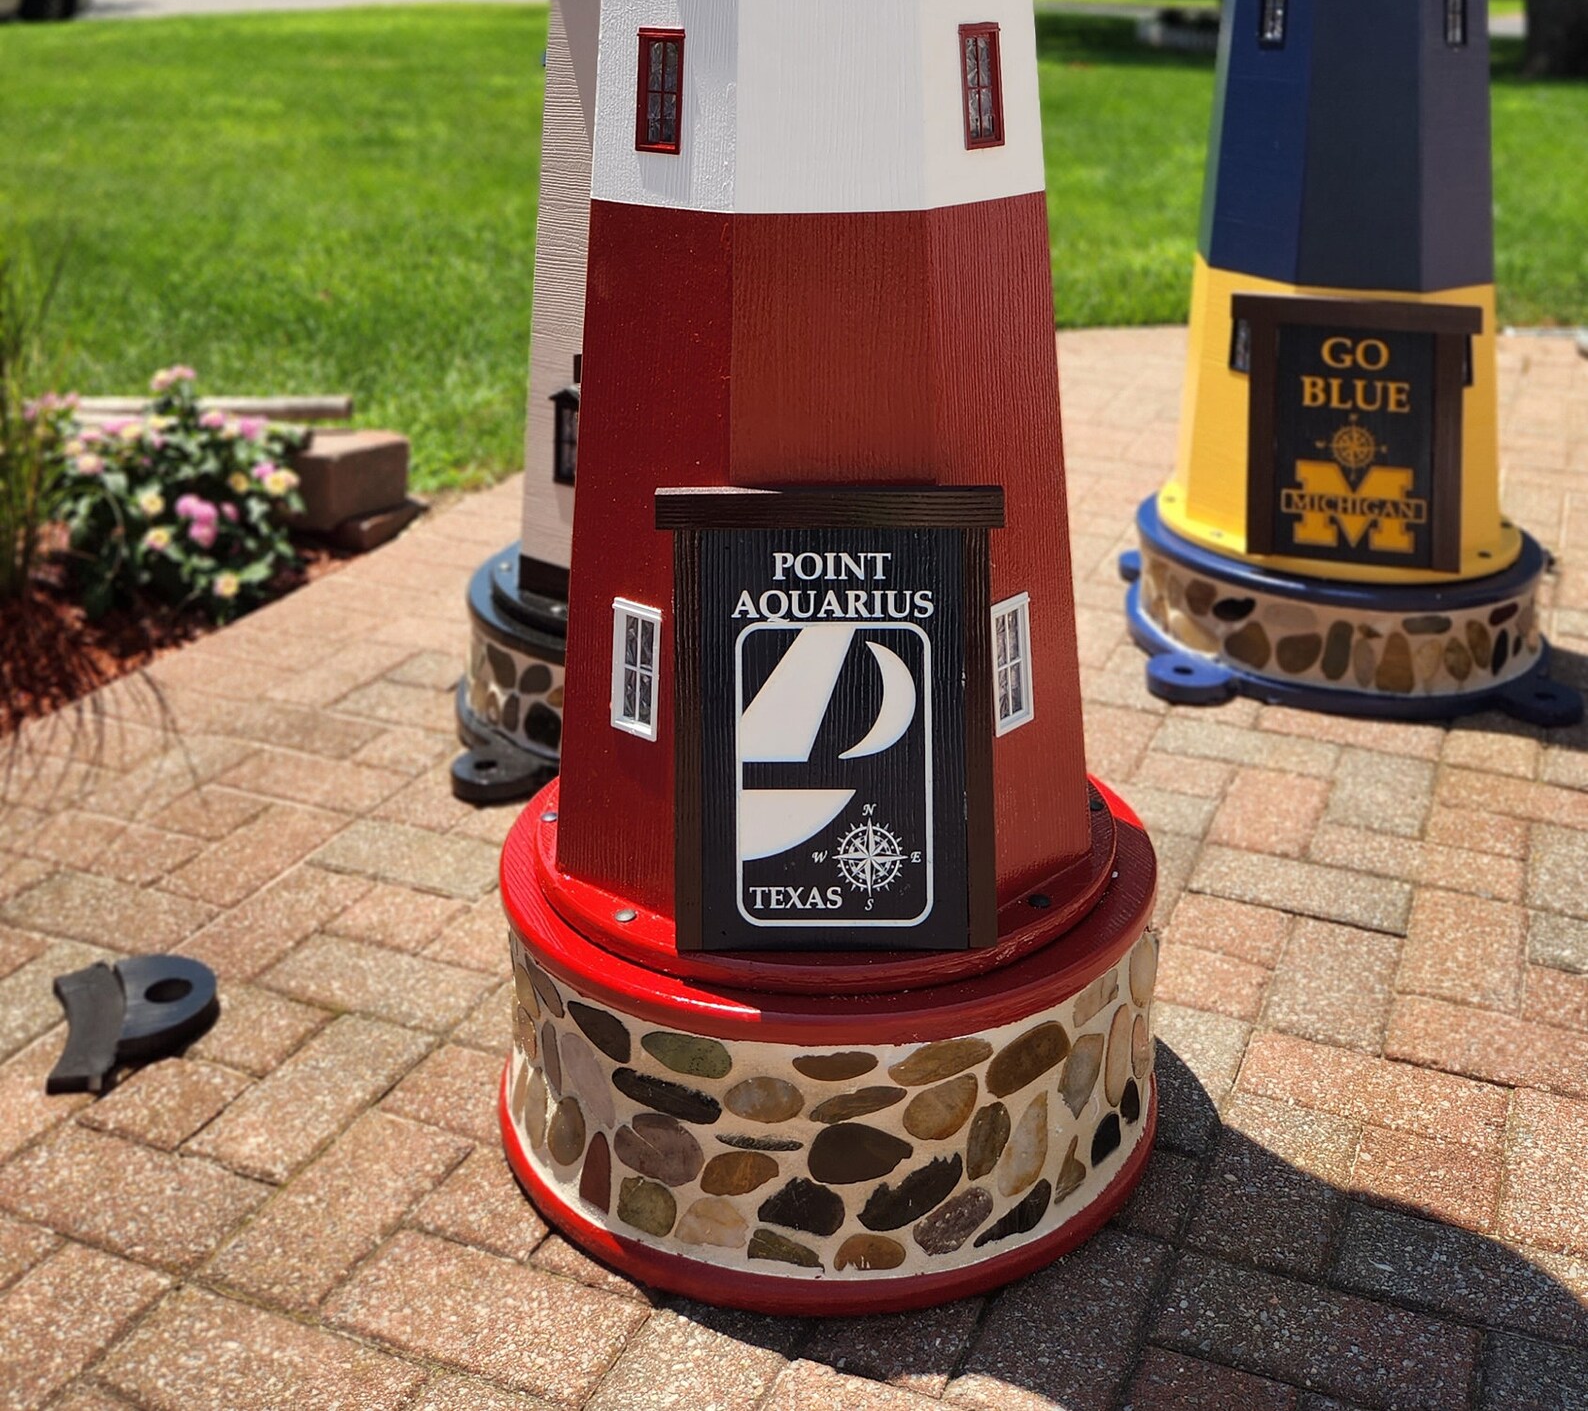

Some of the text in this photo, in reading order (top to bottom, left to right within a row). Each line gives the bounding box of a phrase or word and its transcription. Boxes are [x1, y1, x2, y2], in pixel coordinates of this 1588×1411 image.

[1322, 337, 1390, 370] GO
[1301, 376, 1411, 413] BLUE
[1291, 492, 1415, 518] MICHIGAN
[1295, 459, 1414, 552] M
[773, 552, 891, 580] POINT
[731, 590, 934, 622] AQUARIUS
[862, 804, 876, 816] N
[811, 850, 828, 863] W
[910, 851, 921, 863] E
[749, 887, 842, 909] TEXAS
[864, 898, 874, 911] S
